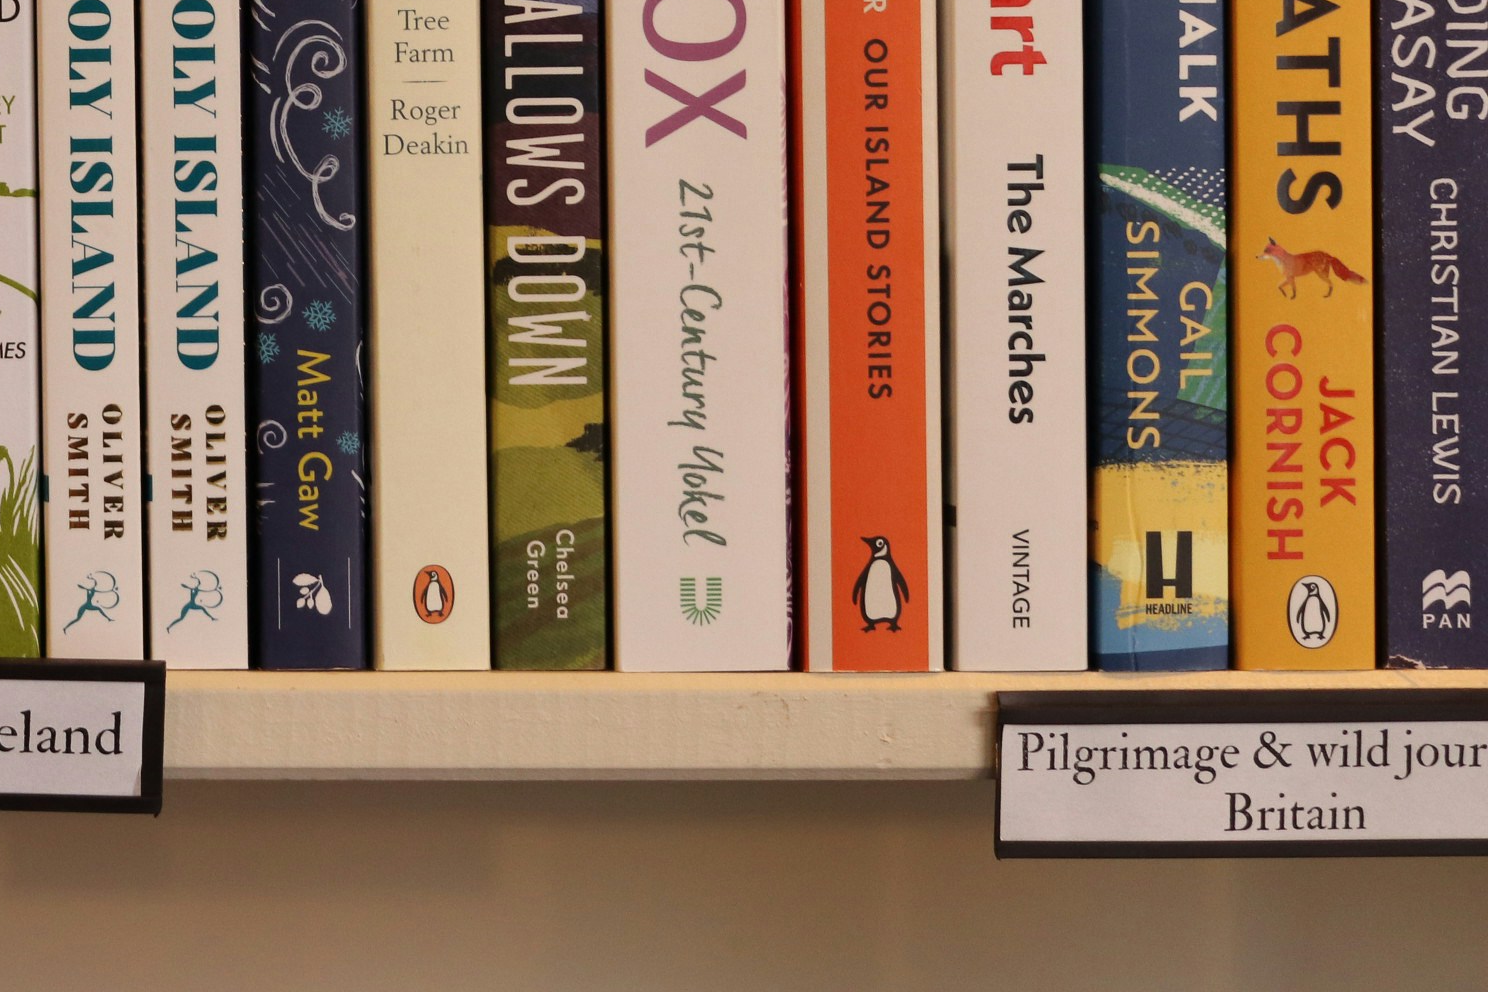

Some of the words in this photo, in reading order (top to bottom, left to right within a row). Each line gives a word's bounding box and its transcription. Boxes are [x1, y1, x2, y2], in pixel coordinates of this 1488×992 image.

[394, 41, 454, 63] Farm
[397, 9, 450, 32] Tree
[390, 99, 461, 126] Roger
[863, 39, 889, 111] OUR
[383, 132, 469, 156] Deakin
[865, 126, 891, 249] ISLAND
[1007, 154, 1044, 234] The
[70, 136, 116, 372] ISLAND
[1429, 178, 1459, 375] CHRISTIAN
[507, 235, 587, 386] DOWN
[667, 179, 726, 432] 21st-Century
[867, 264, 892, 400] STORIES
[1008, 248, 1047, 424] Marches
[1126, 221, 1160, 450] SIMMONS
[1179, 281, 1213, 390] GAIL
[297, 349, 331, 439] Matt
[1265, 324, 1304, 560] CORNISH
[1319, 376, 1356, 507] JACK
[67, 413, 90, 531] SMITH
[101, 403, 124, 540] OLIVER
[298, 451, 333, 531] Gaw
[677, 445, 727, 547] Yokel
[1432, 392, 1461, 505] LEWIS
[526, 540, 546, 609] Green
[555, 529, 575, 619] Chelsea
[1012, 529, 1030, 629] VINTAGE
[1145, 603, 1193, 615] HEADLINE
[1422, 614, 1471, 629] PAN
[1017, 732, 1240, 785] Pilgrimage
[1253, 731, 1292, 768] &
[1307, 729, 1390, 768] wild
[1394, 729, 1488, 780] jour
[1224, 792, 1366, 832] Britain
